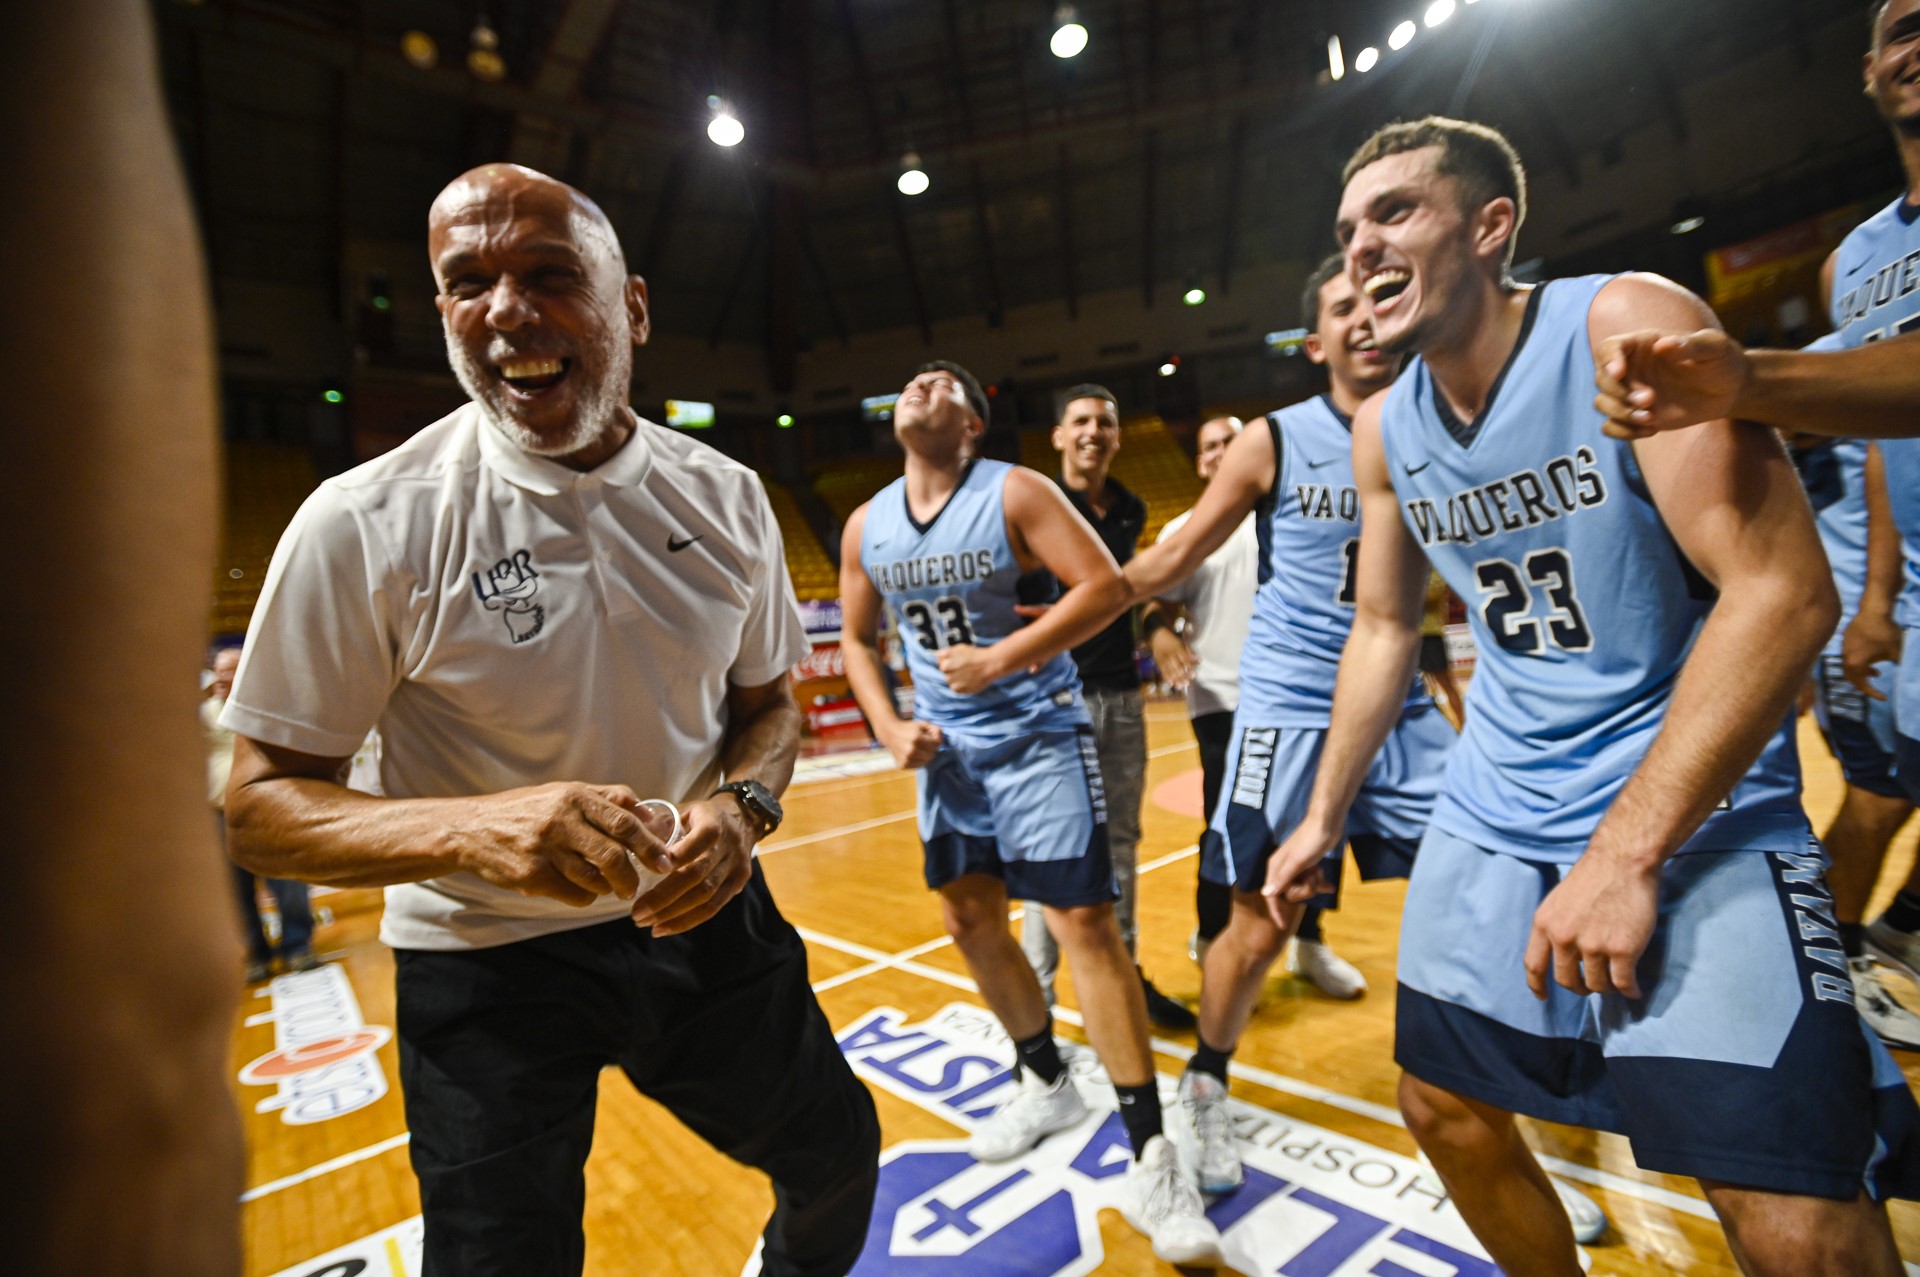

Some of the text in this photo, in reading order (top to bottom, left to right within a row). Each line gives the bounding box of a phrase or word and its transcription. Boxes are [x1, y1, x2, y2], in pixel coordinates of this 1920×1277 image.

[1296, 484, 1360, 524] VAQ
[902, 596, 977, 652] 33
[1473, 545, 1595, 656] 23
[1775, 834, 1857, 1006] BAYAM
[838, 1015, 1014, 1119] ISTA
